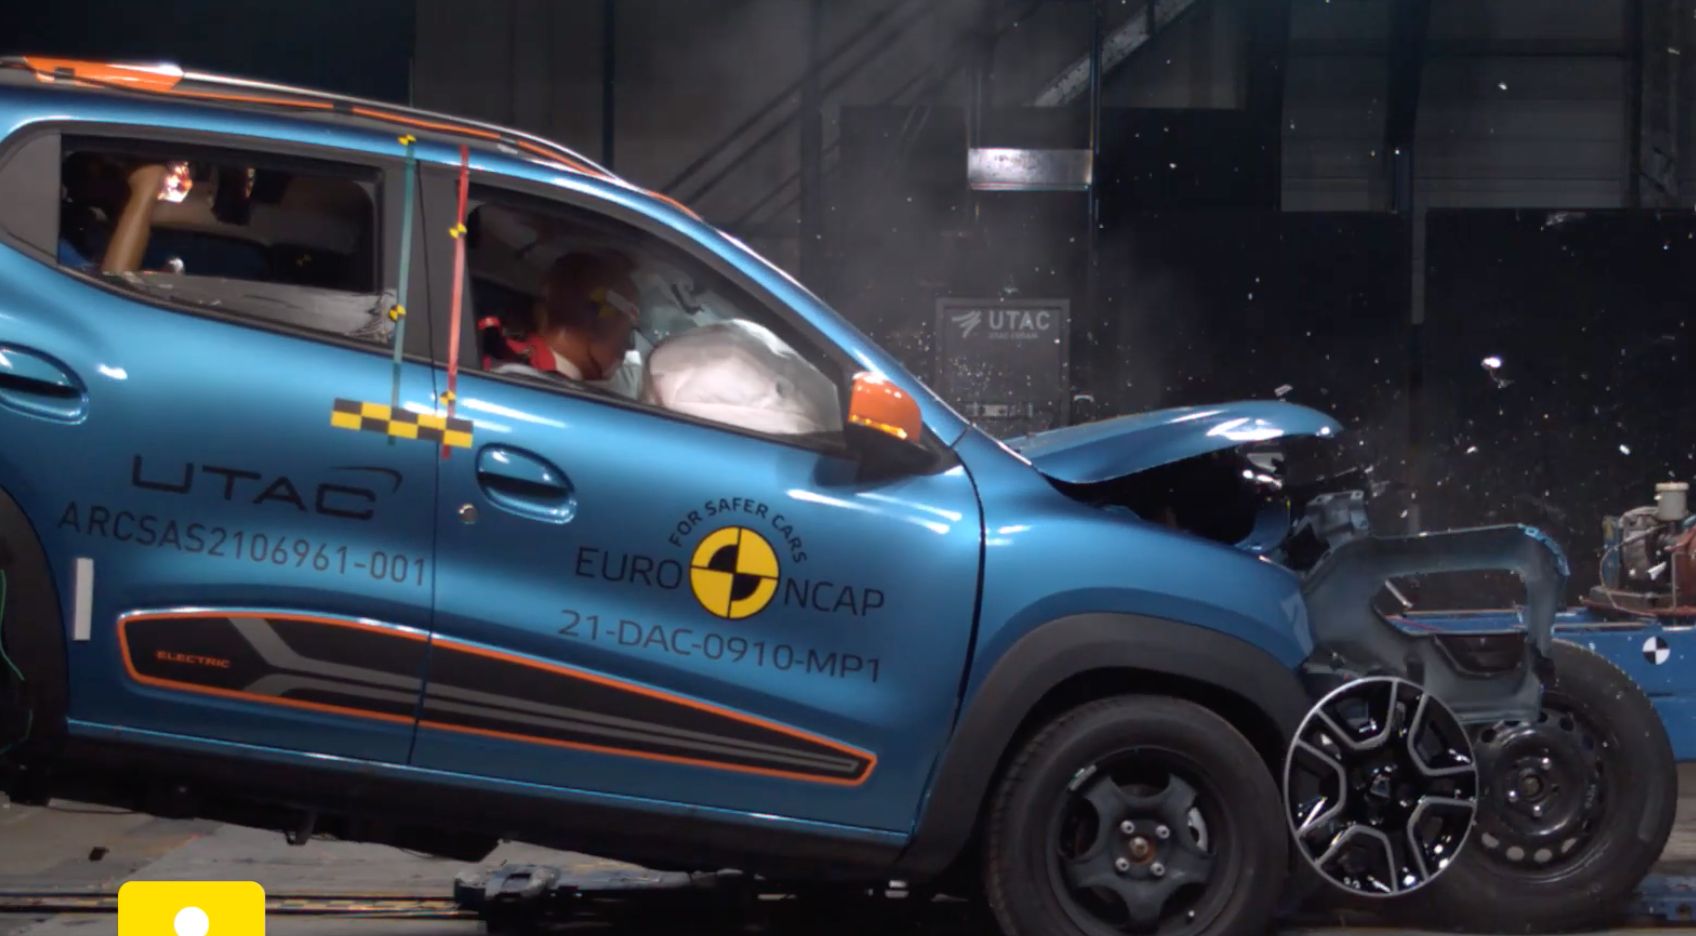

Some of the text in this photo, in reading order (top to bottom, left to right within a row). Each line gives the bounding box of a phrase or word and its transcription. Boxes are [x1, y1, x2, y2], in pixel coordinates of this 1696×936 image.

[989, 310, 1050, 330] UTAC
[131, 455, 379, 520] UTAC
[58, 501, 425, 586] ARCSAS2106961-001
[668, 497, 807, 563] FOR SAFER CARS
[575, 546, 885, 616] EURO NCAP
[156, 650, 230, 669] ELECTRIC
[557, 609, 881, 683] 21-DAC-0910-MP1
